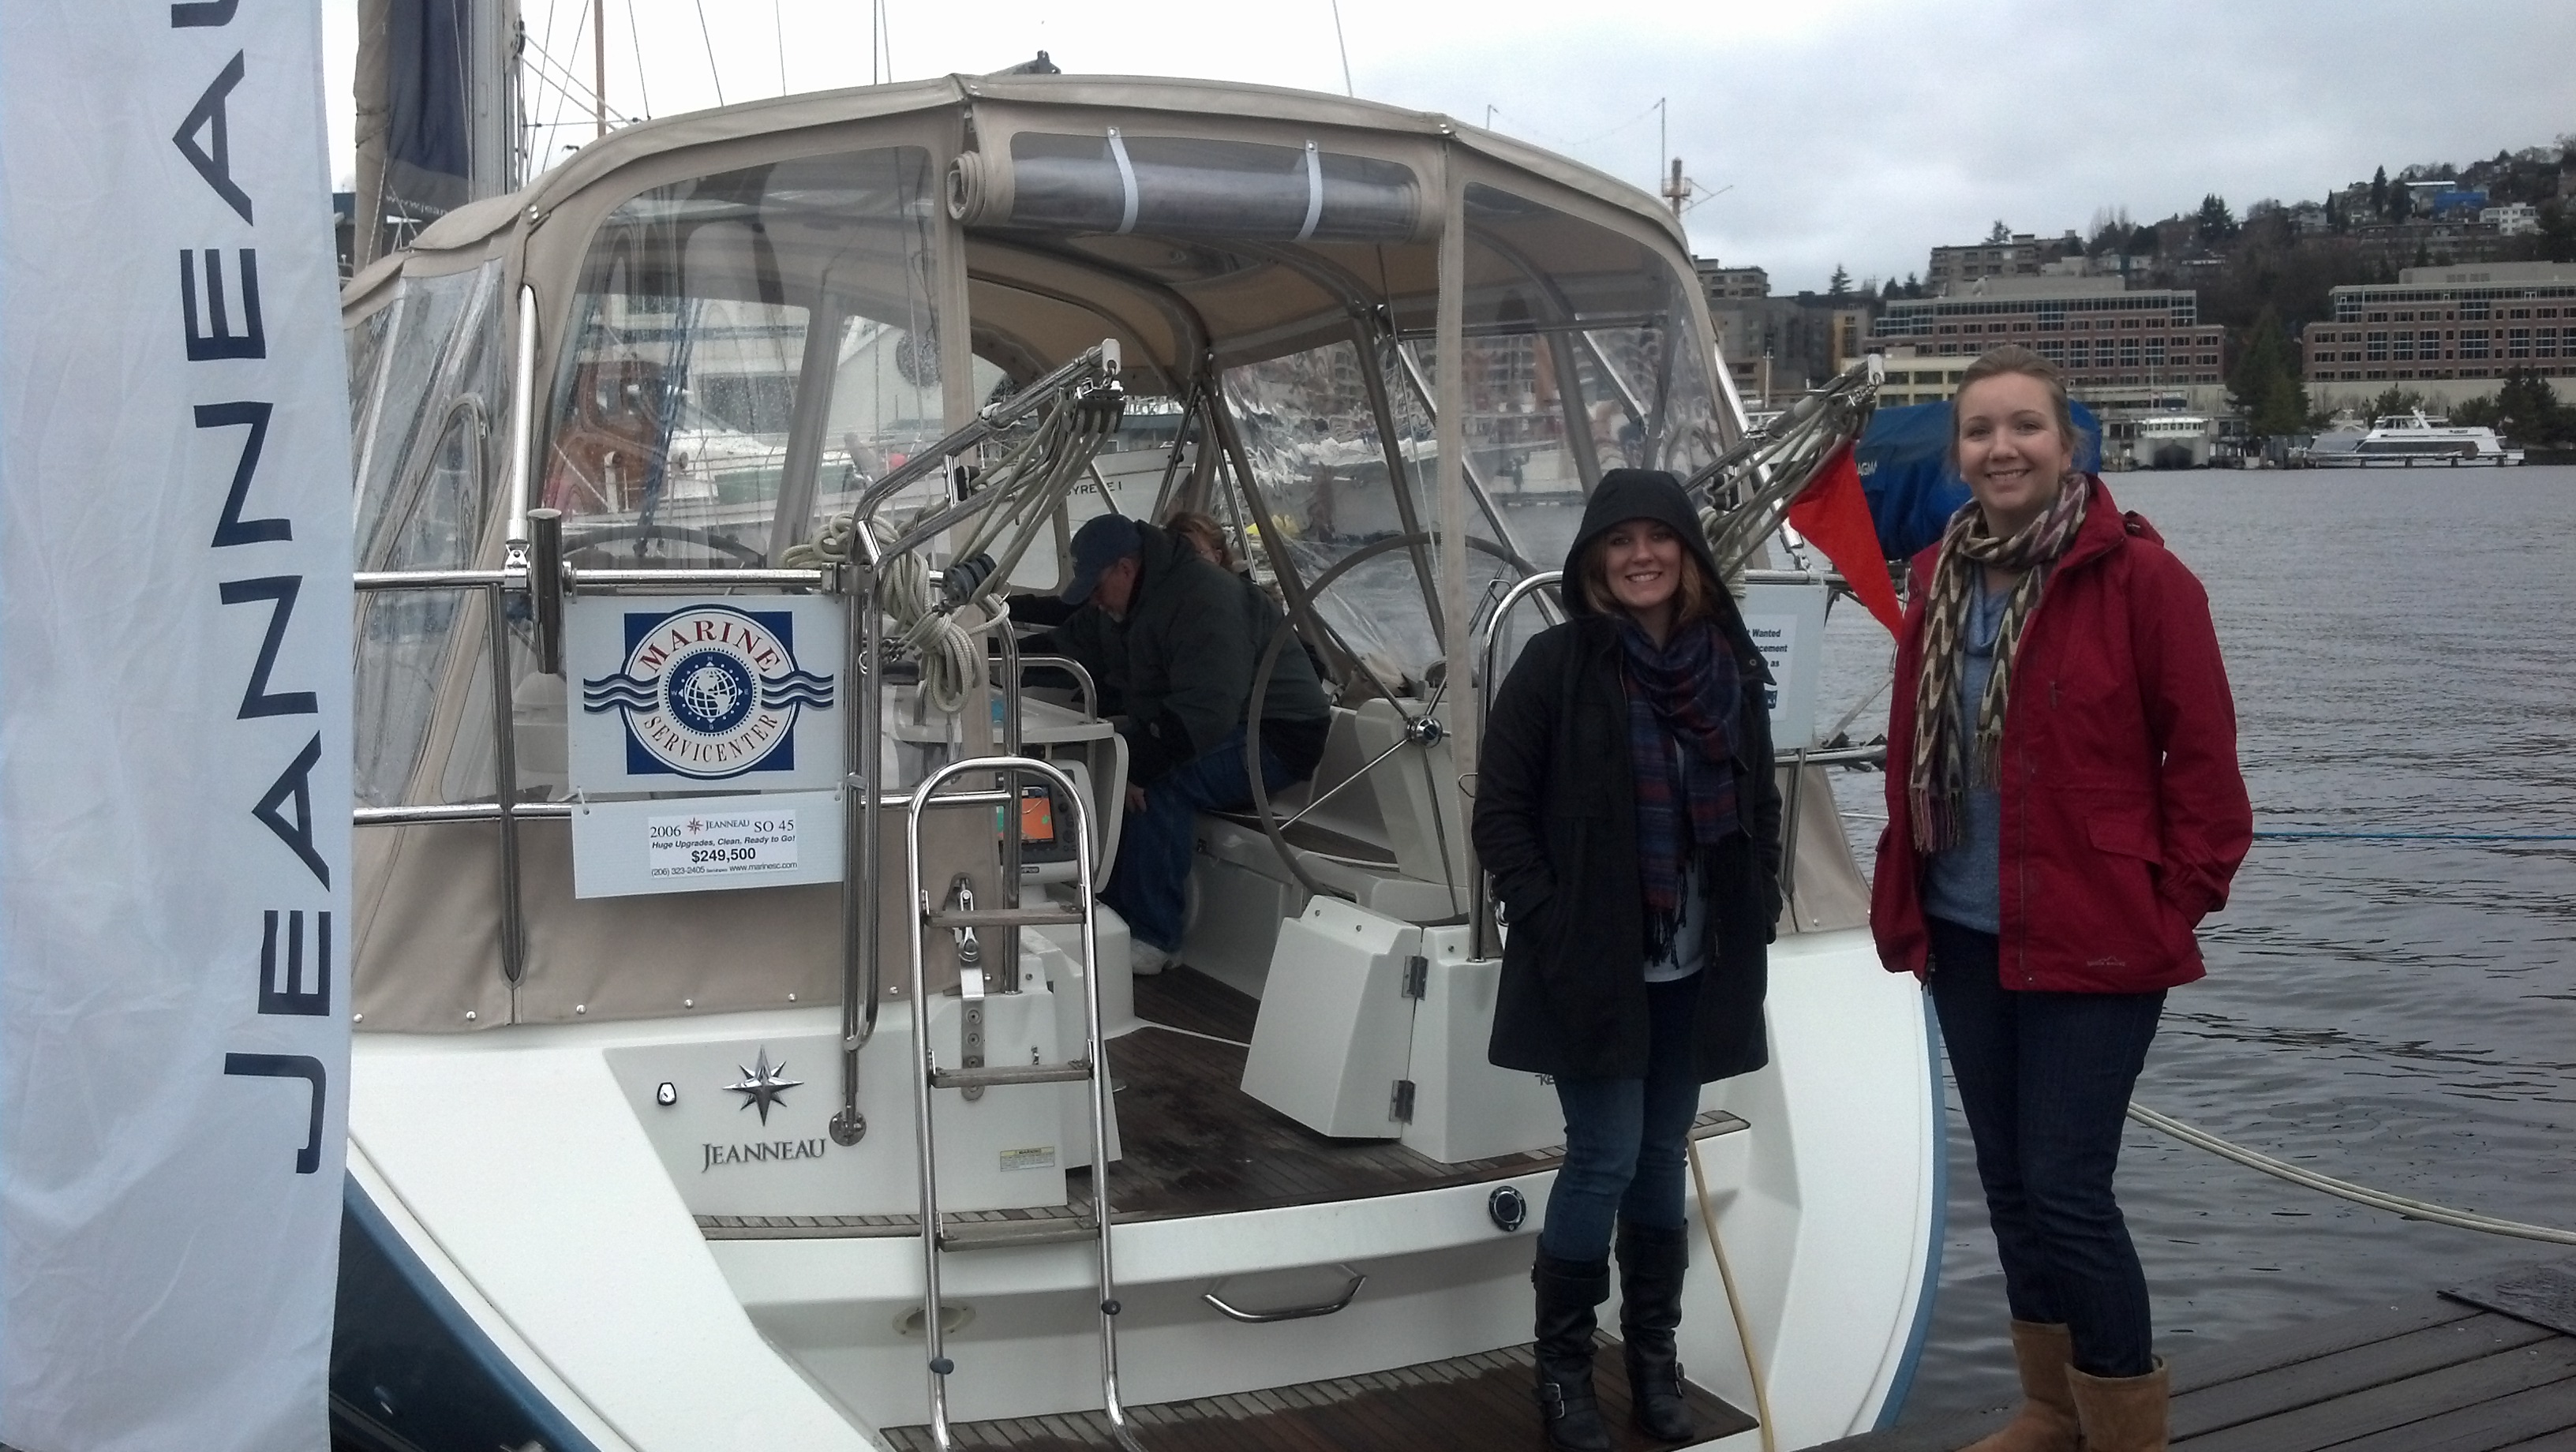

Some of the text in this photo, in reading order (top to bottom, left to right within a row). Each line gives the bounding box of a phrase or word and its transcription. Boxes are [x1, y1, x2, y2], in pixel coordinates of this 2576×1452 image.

[1065, 481, 1115, 496] YREE
[1752, 628, 1781, 638] Wanted
[638, 620, 781, 673] MARINE
[1757, 644, 1788, 653] cement
[643, 713, 778, 763] SERVICENTER
[650, 818, 795, 839] 2006 JEANNEAU SO 45
[652, 841, 673, 850] Huge
[675, 839, 716, 849] Upgrades,
[744, 835, 770, 845] Ready
[771, 834, 780, 843] to
[691, 847, 757, 865] $249,500
[650, 868, 671, 877] (206)
[671, 865, 706, 876] 323-2405
[728, 862, 799, 874] www.marinesc.com
[702, 1138, 826, 1173] JEANNEAU
